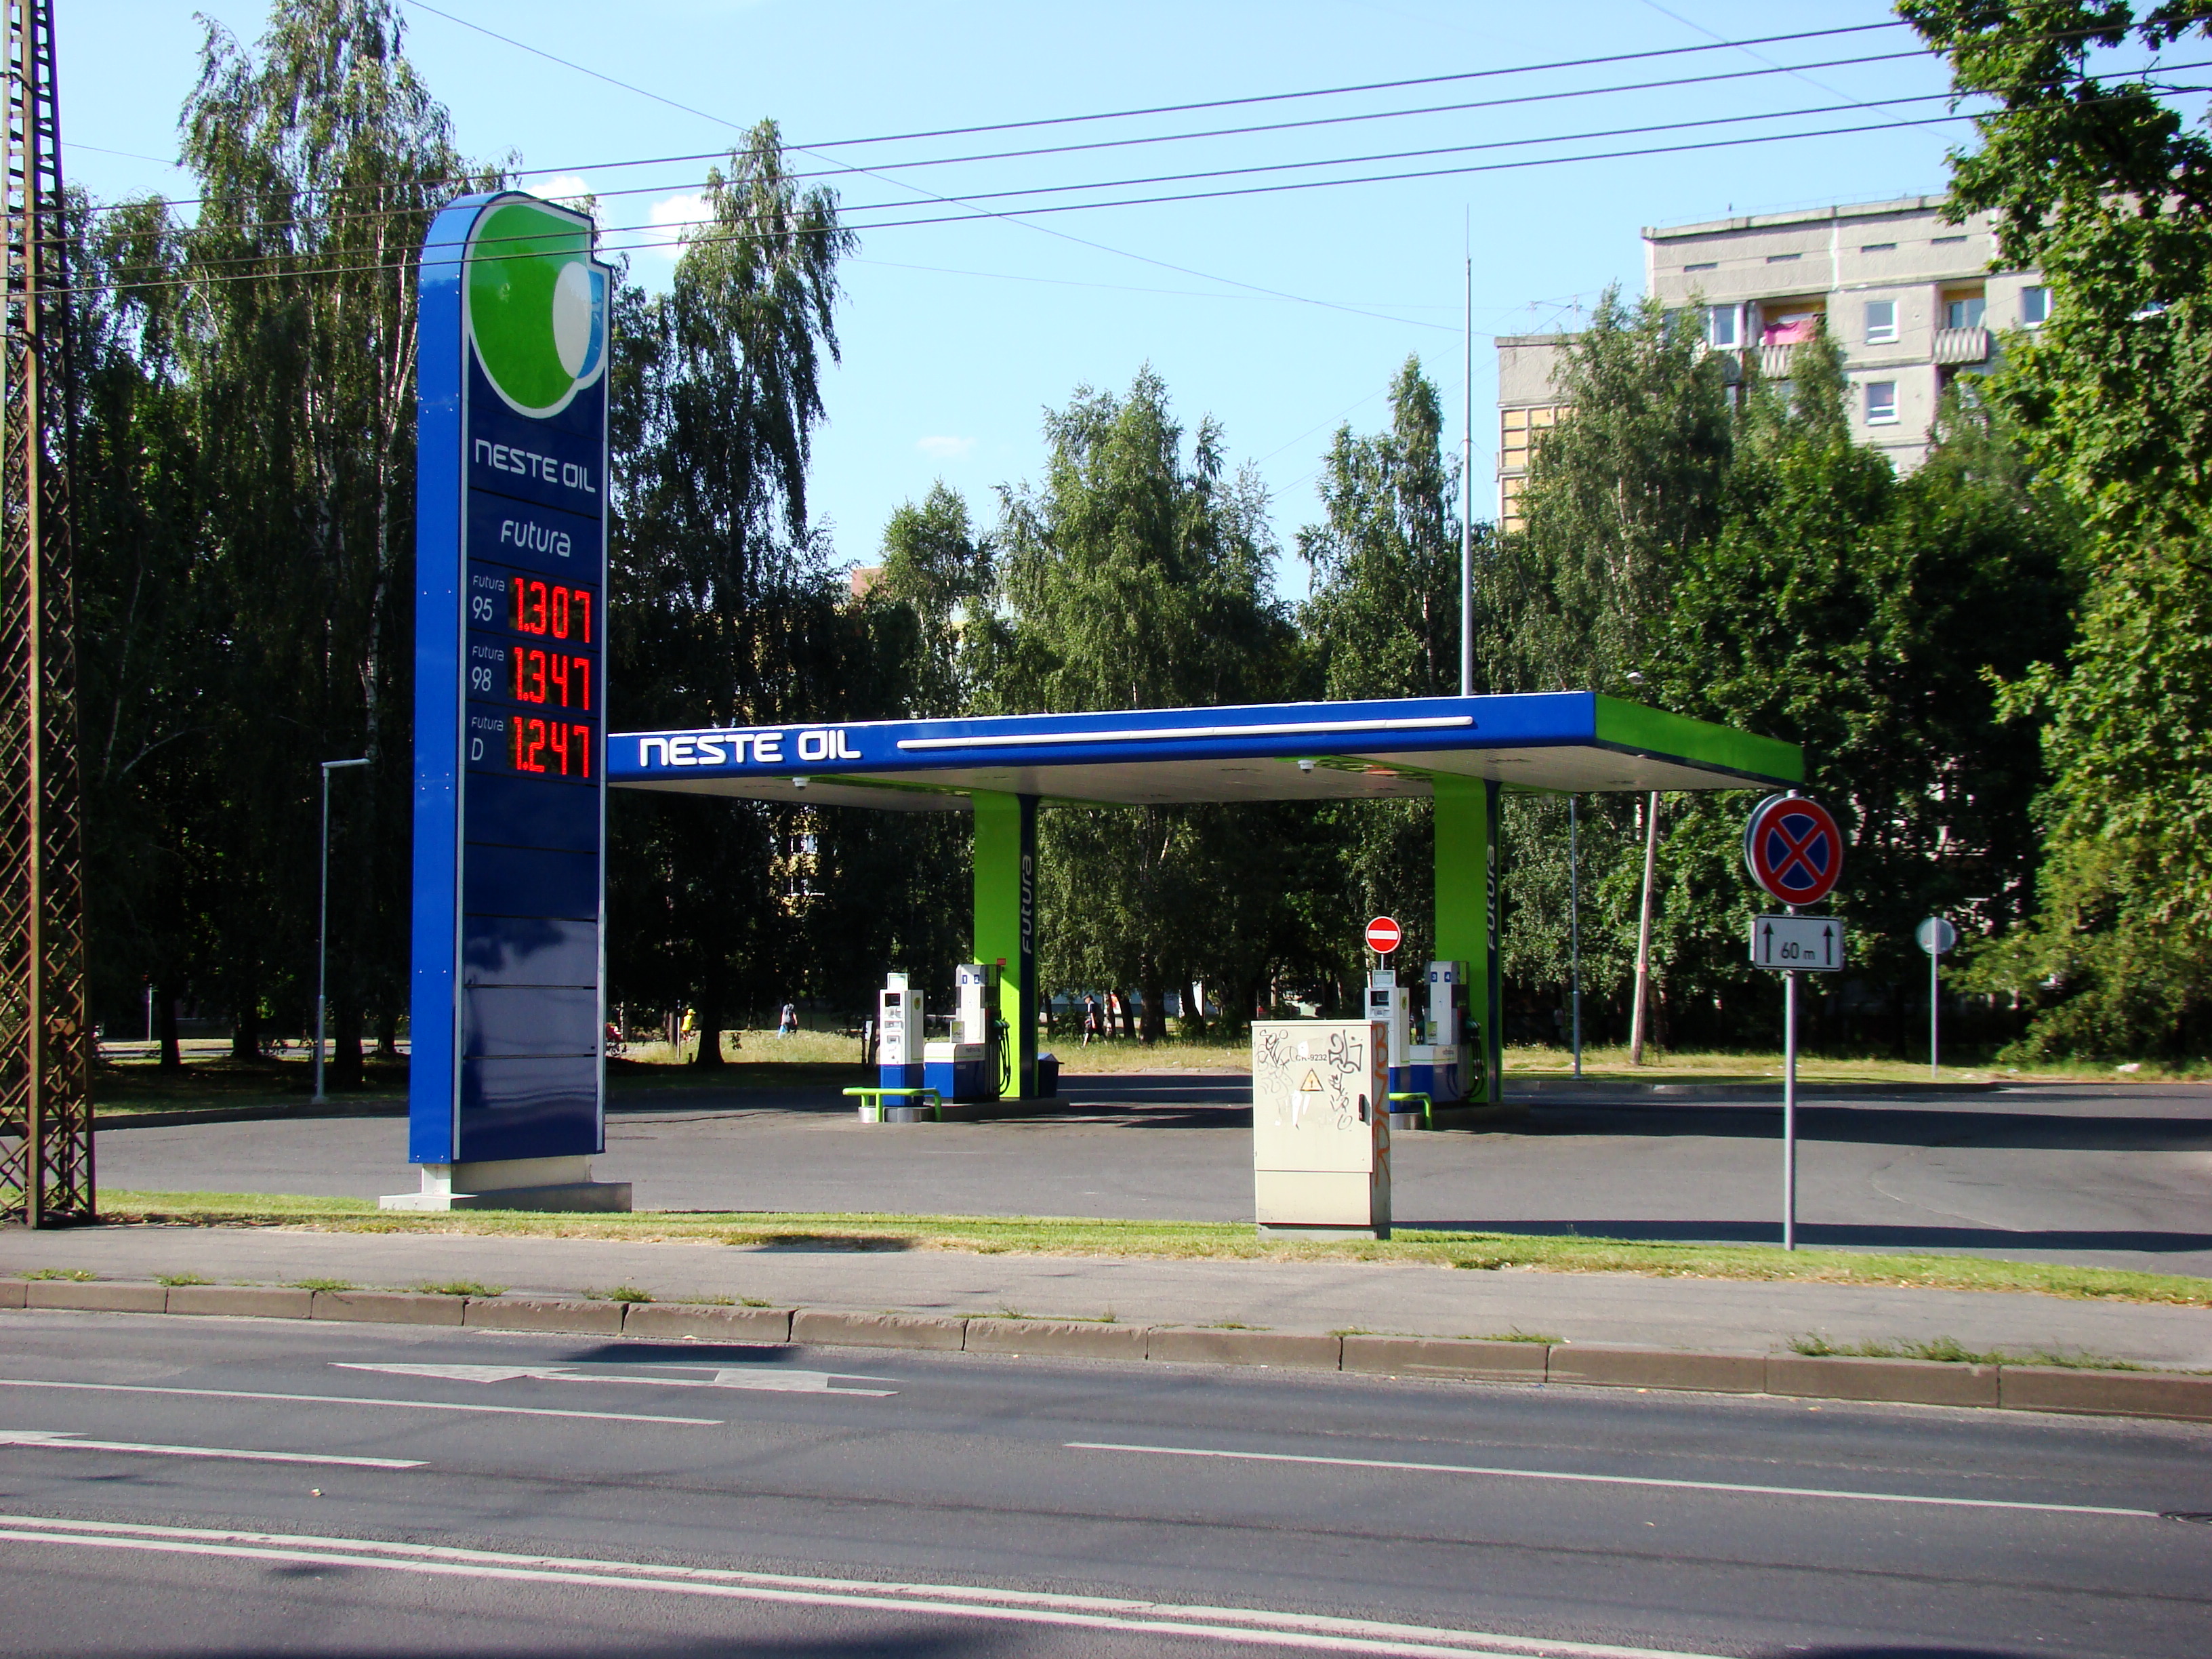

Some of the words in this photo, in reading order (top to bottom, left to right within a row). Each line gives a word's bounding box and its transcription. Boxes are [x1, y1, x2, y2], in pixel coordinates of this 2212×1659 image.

[476, 438, 558, 483] NESTE
[562, 462, 596, 493] OIL
[500, 519, 571, 558] Futura
[472, 575, 506, 592] Futura
[472, 596, 493, 622] 95
[514, 577, 591, 643] 1.307
[472, 645, 505, 661] Futura
[472, 665, 492, 692] 98
[514, 647, 590, 711] 1.347
[471, 716, 504, 732] Futura
[470, 737, 484, 761] D
[514, 716, 590, 778] 1.247
[639, 731, 784, 767] NESTE
[798, 729, 862, 762] OIL
[1021, 854, 1032, 955] Futura
[1487, 844, 1496, 951] Futura
[1780, 941, 1800, 960] 60
[1803, 949, 1816, 960] m
